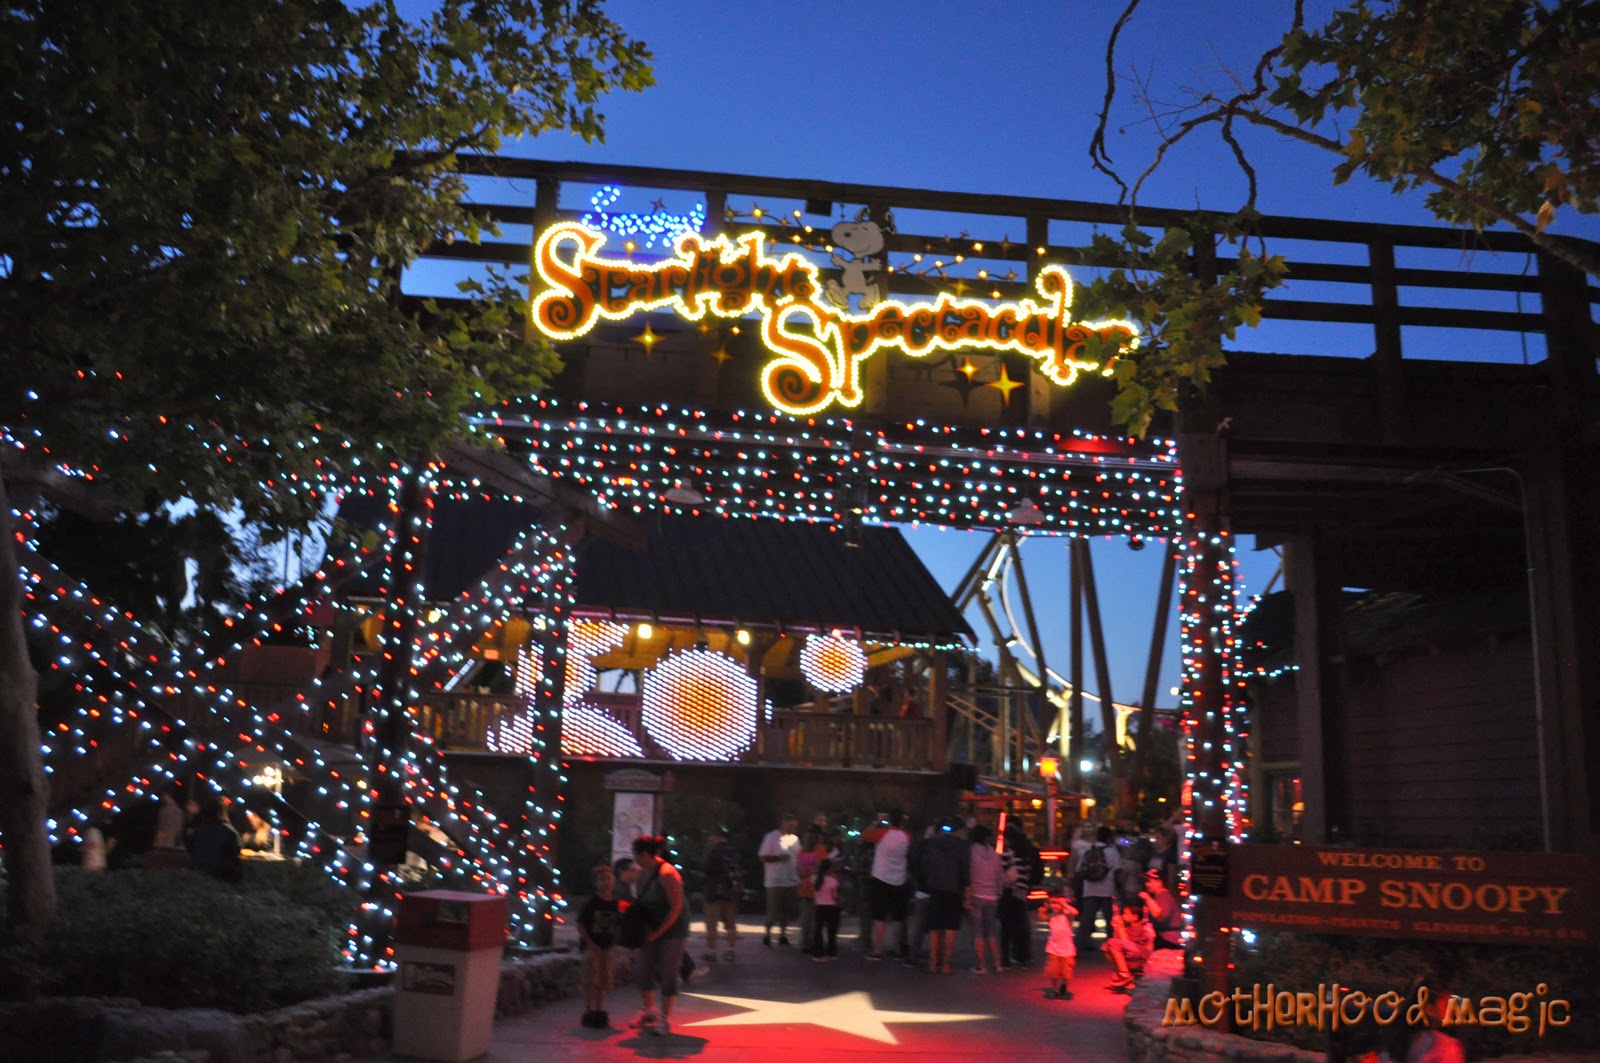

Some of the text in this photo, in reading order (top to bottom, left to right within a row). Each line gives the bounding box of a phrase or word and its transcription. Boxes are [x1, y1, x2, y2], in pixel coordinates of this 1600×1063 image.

[532, 221, 821, 340] Starlight
[761, 264, 1140, 415] Spectacular
[1241, 873, 1367, 905] CAMP
[1379, 879, 1569, 914] SNOOPY
[1316, 851, 1486, 872] WELCOME TO
